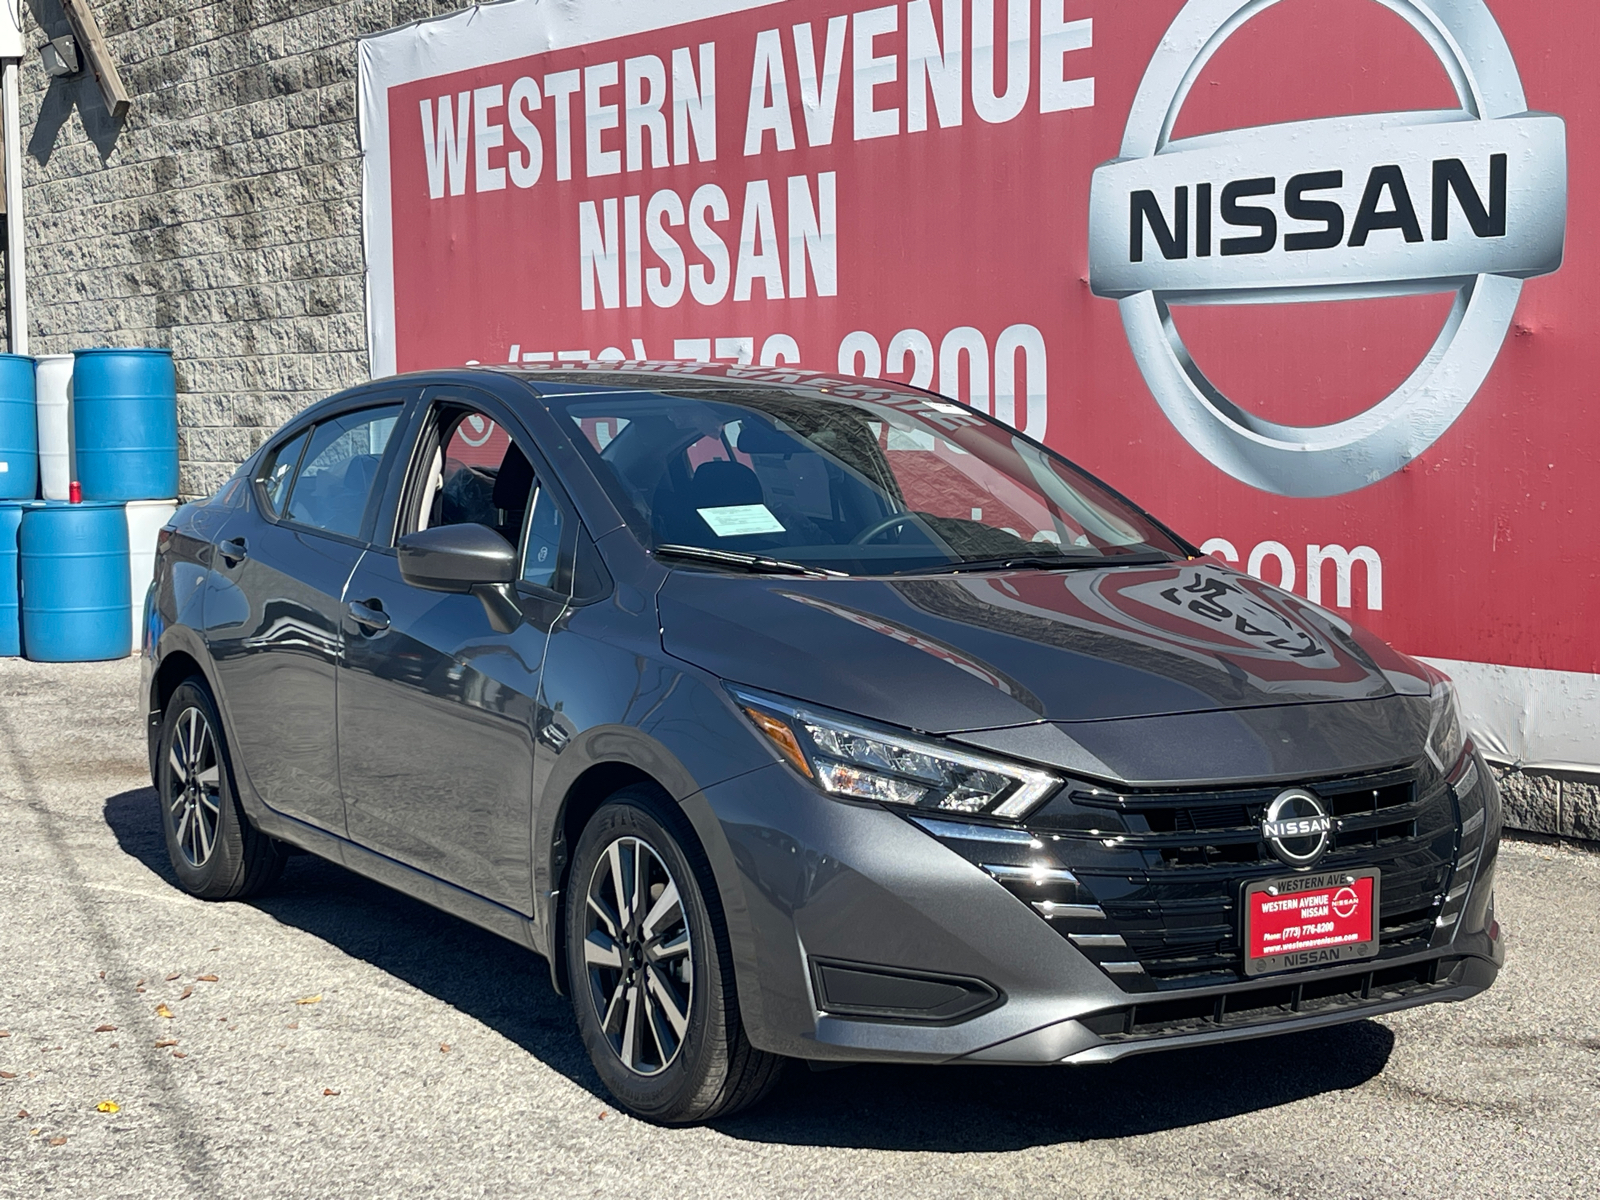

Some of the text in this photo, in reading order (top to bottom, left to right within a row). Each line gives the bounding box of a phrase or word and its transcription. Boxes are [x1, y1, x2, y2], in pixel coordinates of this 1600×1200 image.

[420, 0, 1095, 199] WESTERN AVENUE
[1129, 153, 1507, 263] NISSAN
[579, 171, 837, 311] NISSAN
[1264, 818, 1331, 837] NISSAN
[1277, 877, 1324, 892] WESTERN
[1262, 894, 1329, 913] WESTERN AVENUE
[1301, 905, 1329, 919] NISSAN
[1332, 898, 1359, 907] NISSAN
[1282, 926, 1301, 940] (773)
[1302, 921, 1334, 936] 776-8200
[1285, 948, 1339, 967] NISSAN
